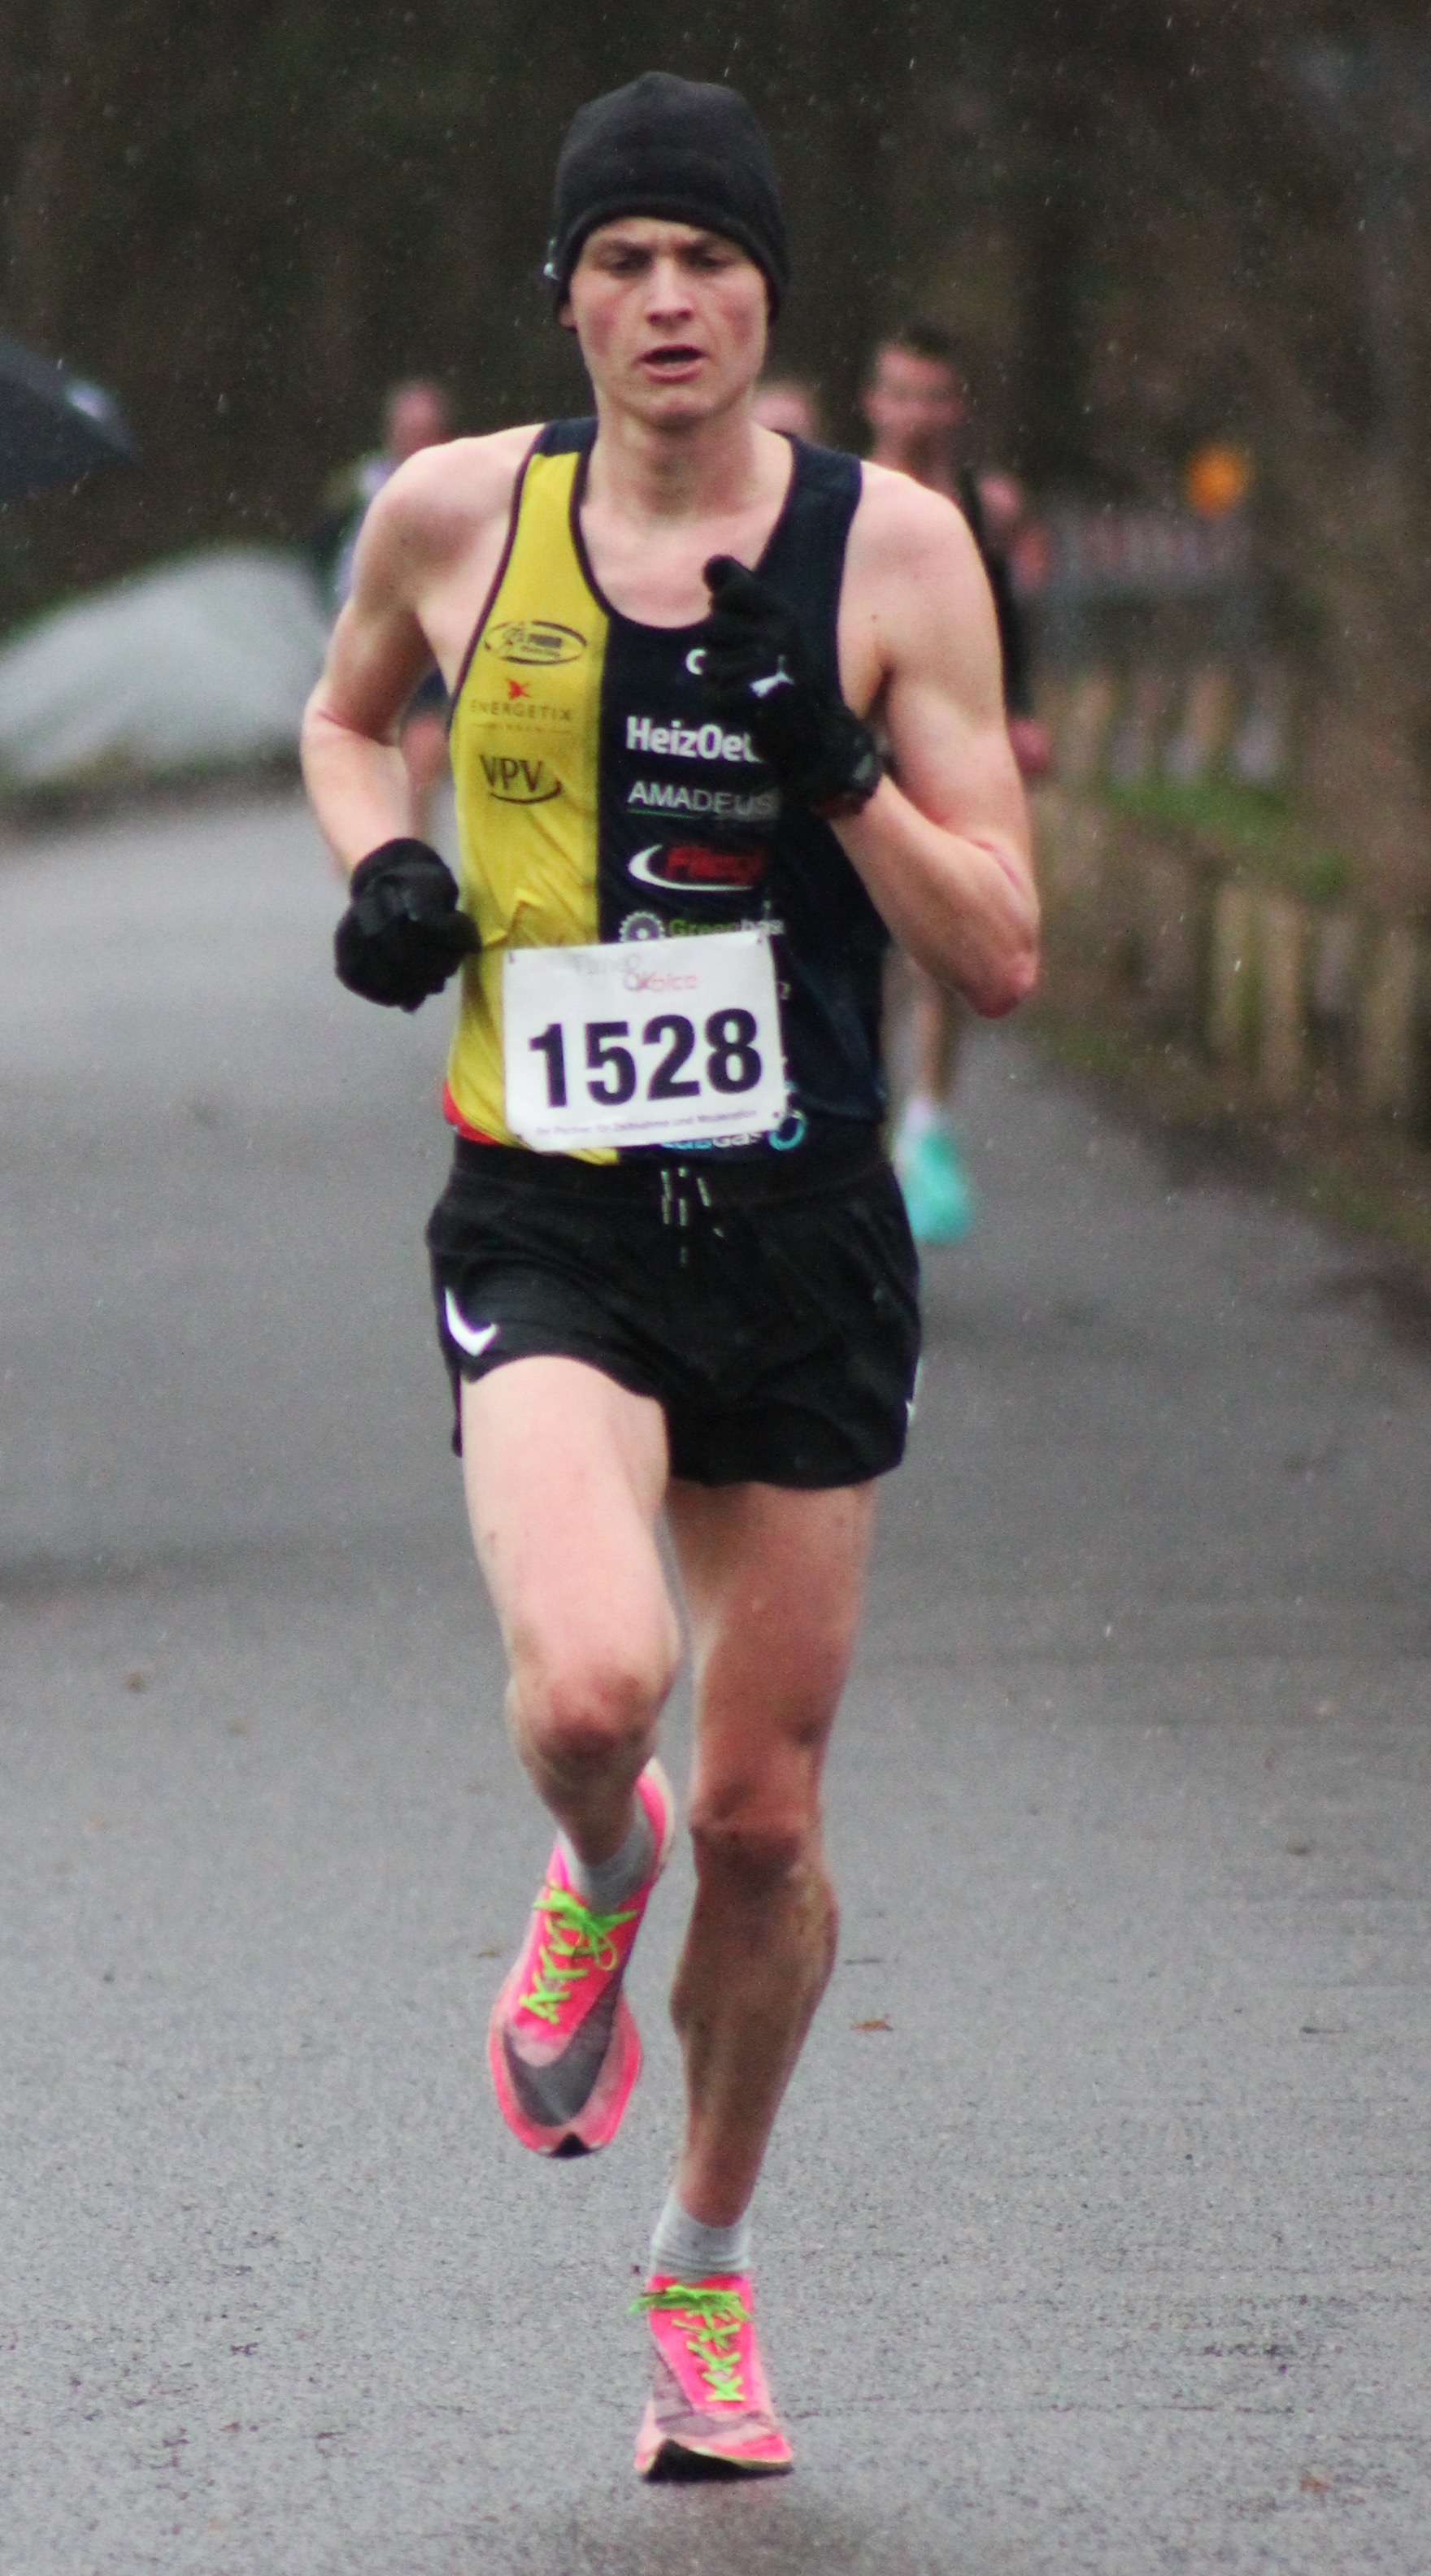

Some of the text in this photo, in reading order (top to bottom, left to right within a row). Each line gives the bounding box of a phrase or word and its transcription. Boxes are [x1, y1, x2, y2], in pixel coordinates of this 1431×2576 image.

[470, 700, 572, 721] ENERGETIX
[479, 753, 544, 793] VPV
[627, 779, 776, 816] AMADEUS
[528, 1007, 763, 1108] 1528
